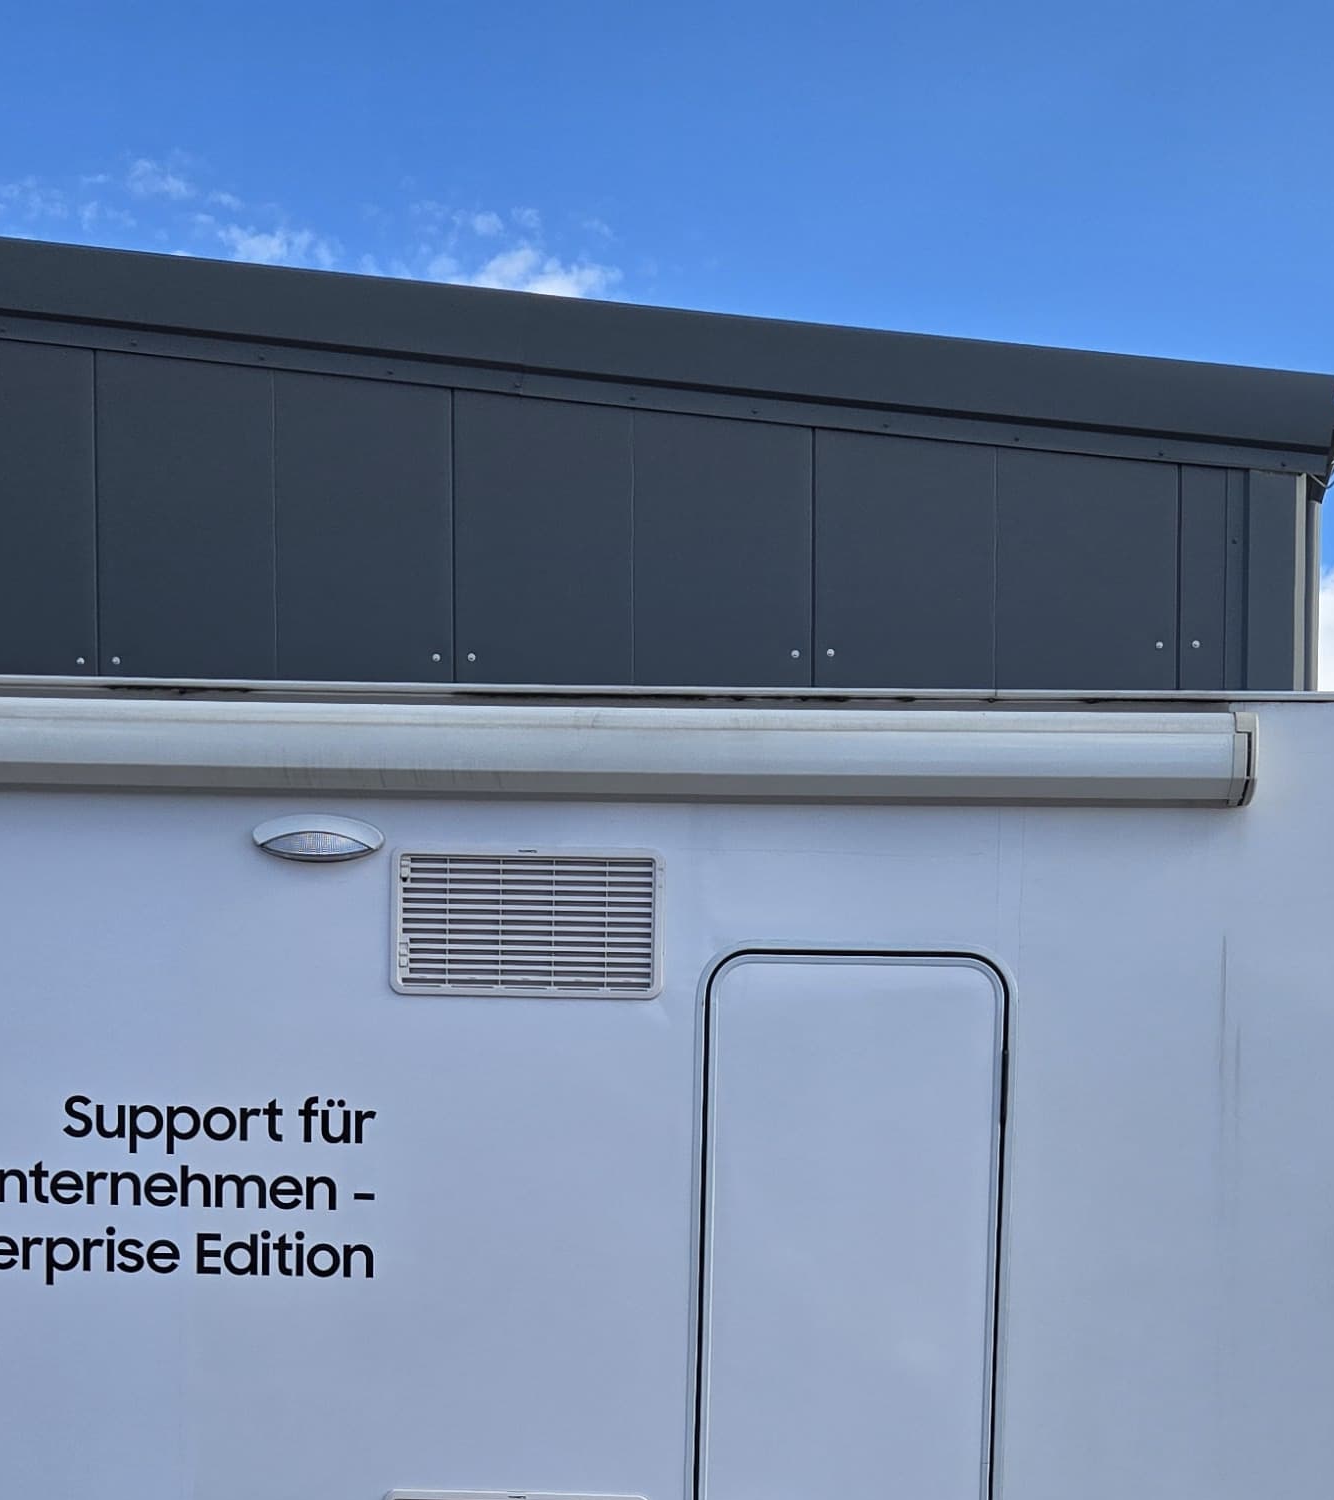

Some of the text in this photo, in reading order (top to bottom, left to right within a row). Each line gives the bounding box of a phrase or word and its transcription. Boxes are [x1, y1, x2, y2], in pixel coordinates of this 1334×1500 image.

[62, 1095, 377, 1154] Support für
[196, 1229, 374, 1279] Edition
